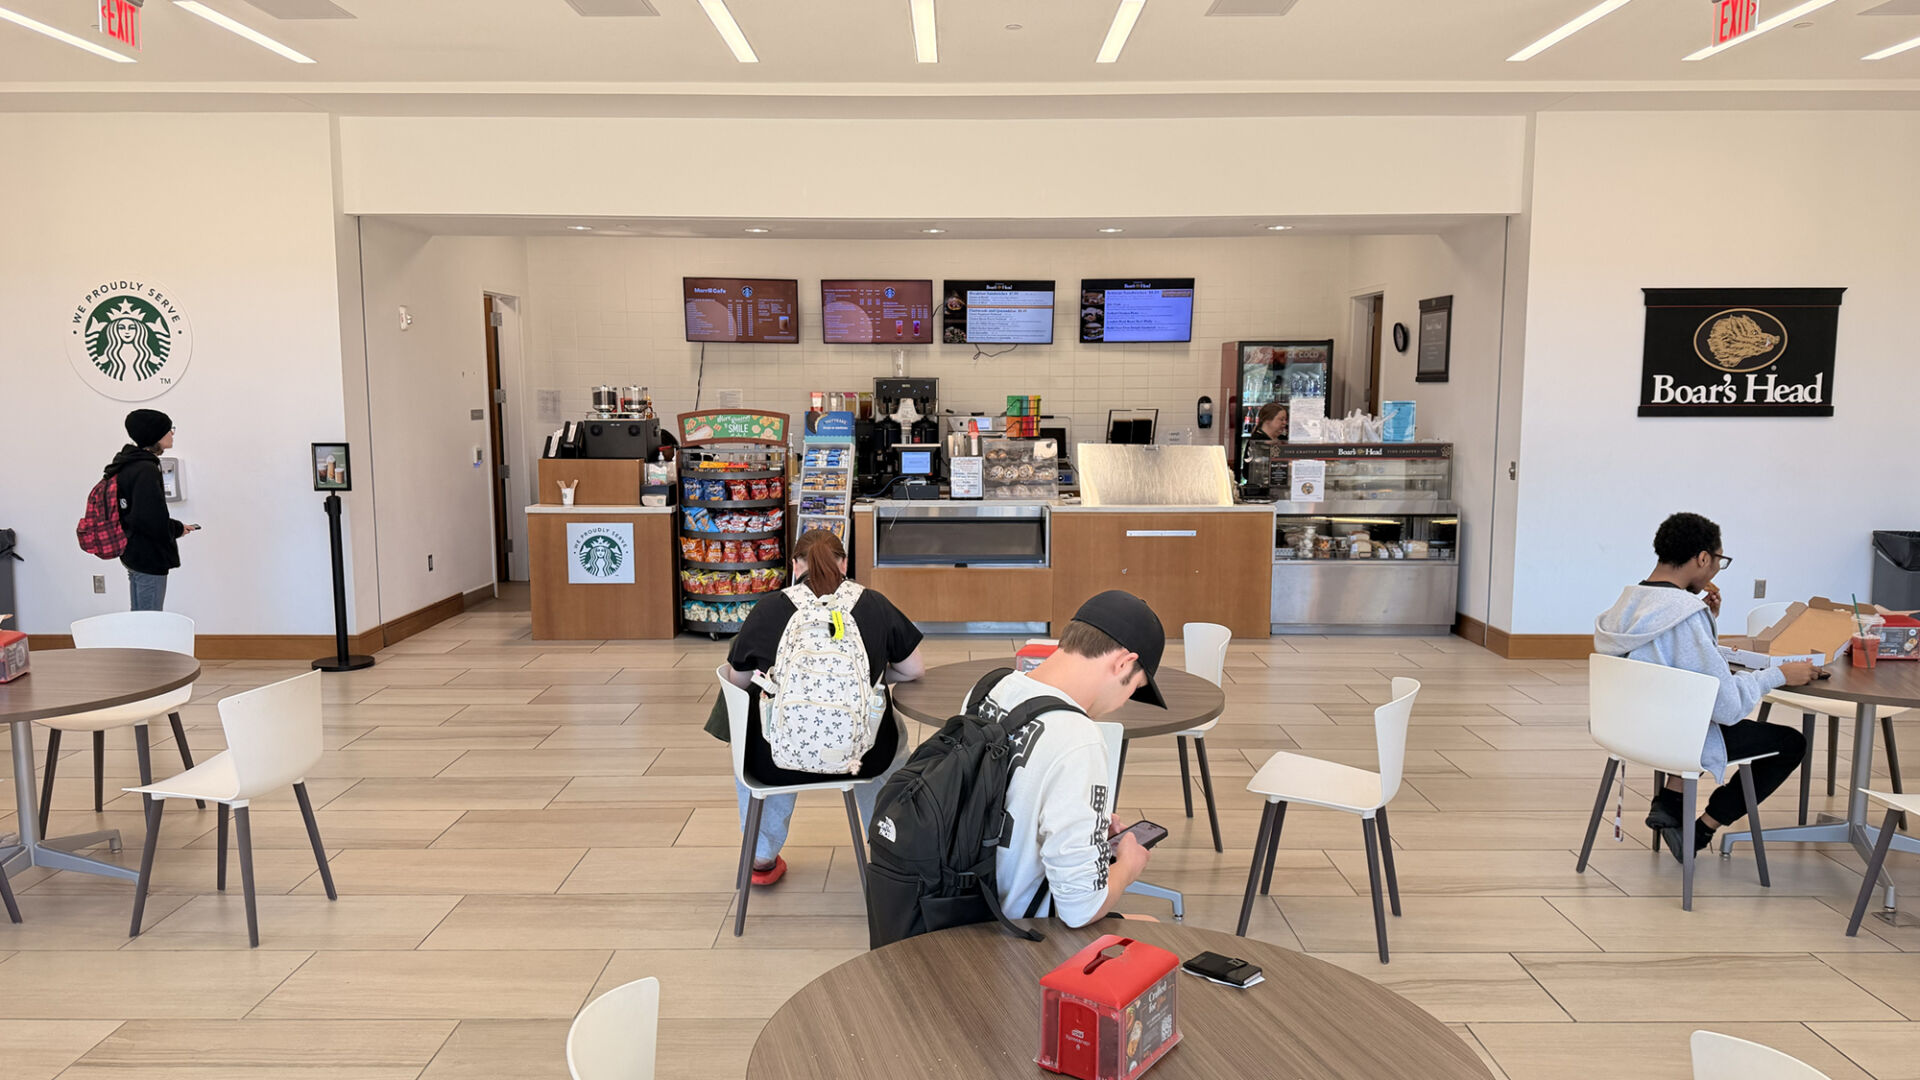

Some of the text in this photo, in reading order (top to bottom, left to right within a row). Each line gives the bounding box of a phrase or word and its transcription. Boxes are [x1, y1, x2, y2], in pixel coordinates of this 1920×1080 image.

[107, 0, 136, 47] EXIT
[1719, 0, 1751, 43] EXIT
[72, 280, 181, 324] WE PROUDLY SERVE
[1651, 372, 1823, 404] Boar's Head
[728, 423, 748, 433] SMILE
[1365, 447, 1383, 456] Head
[580, 527, 610, 539] PROUDLY
